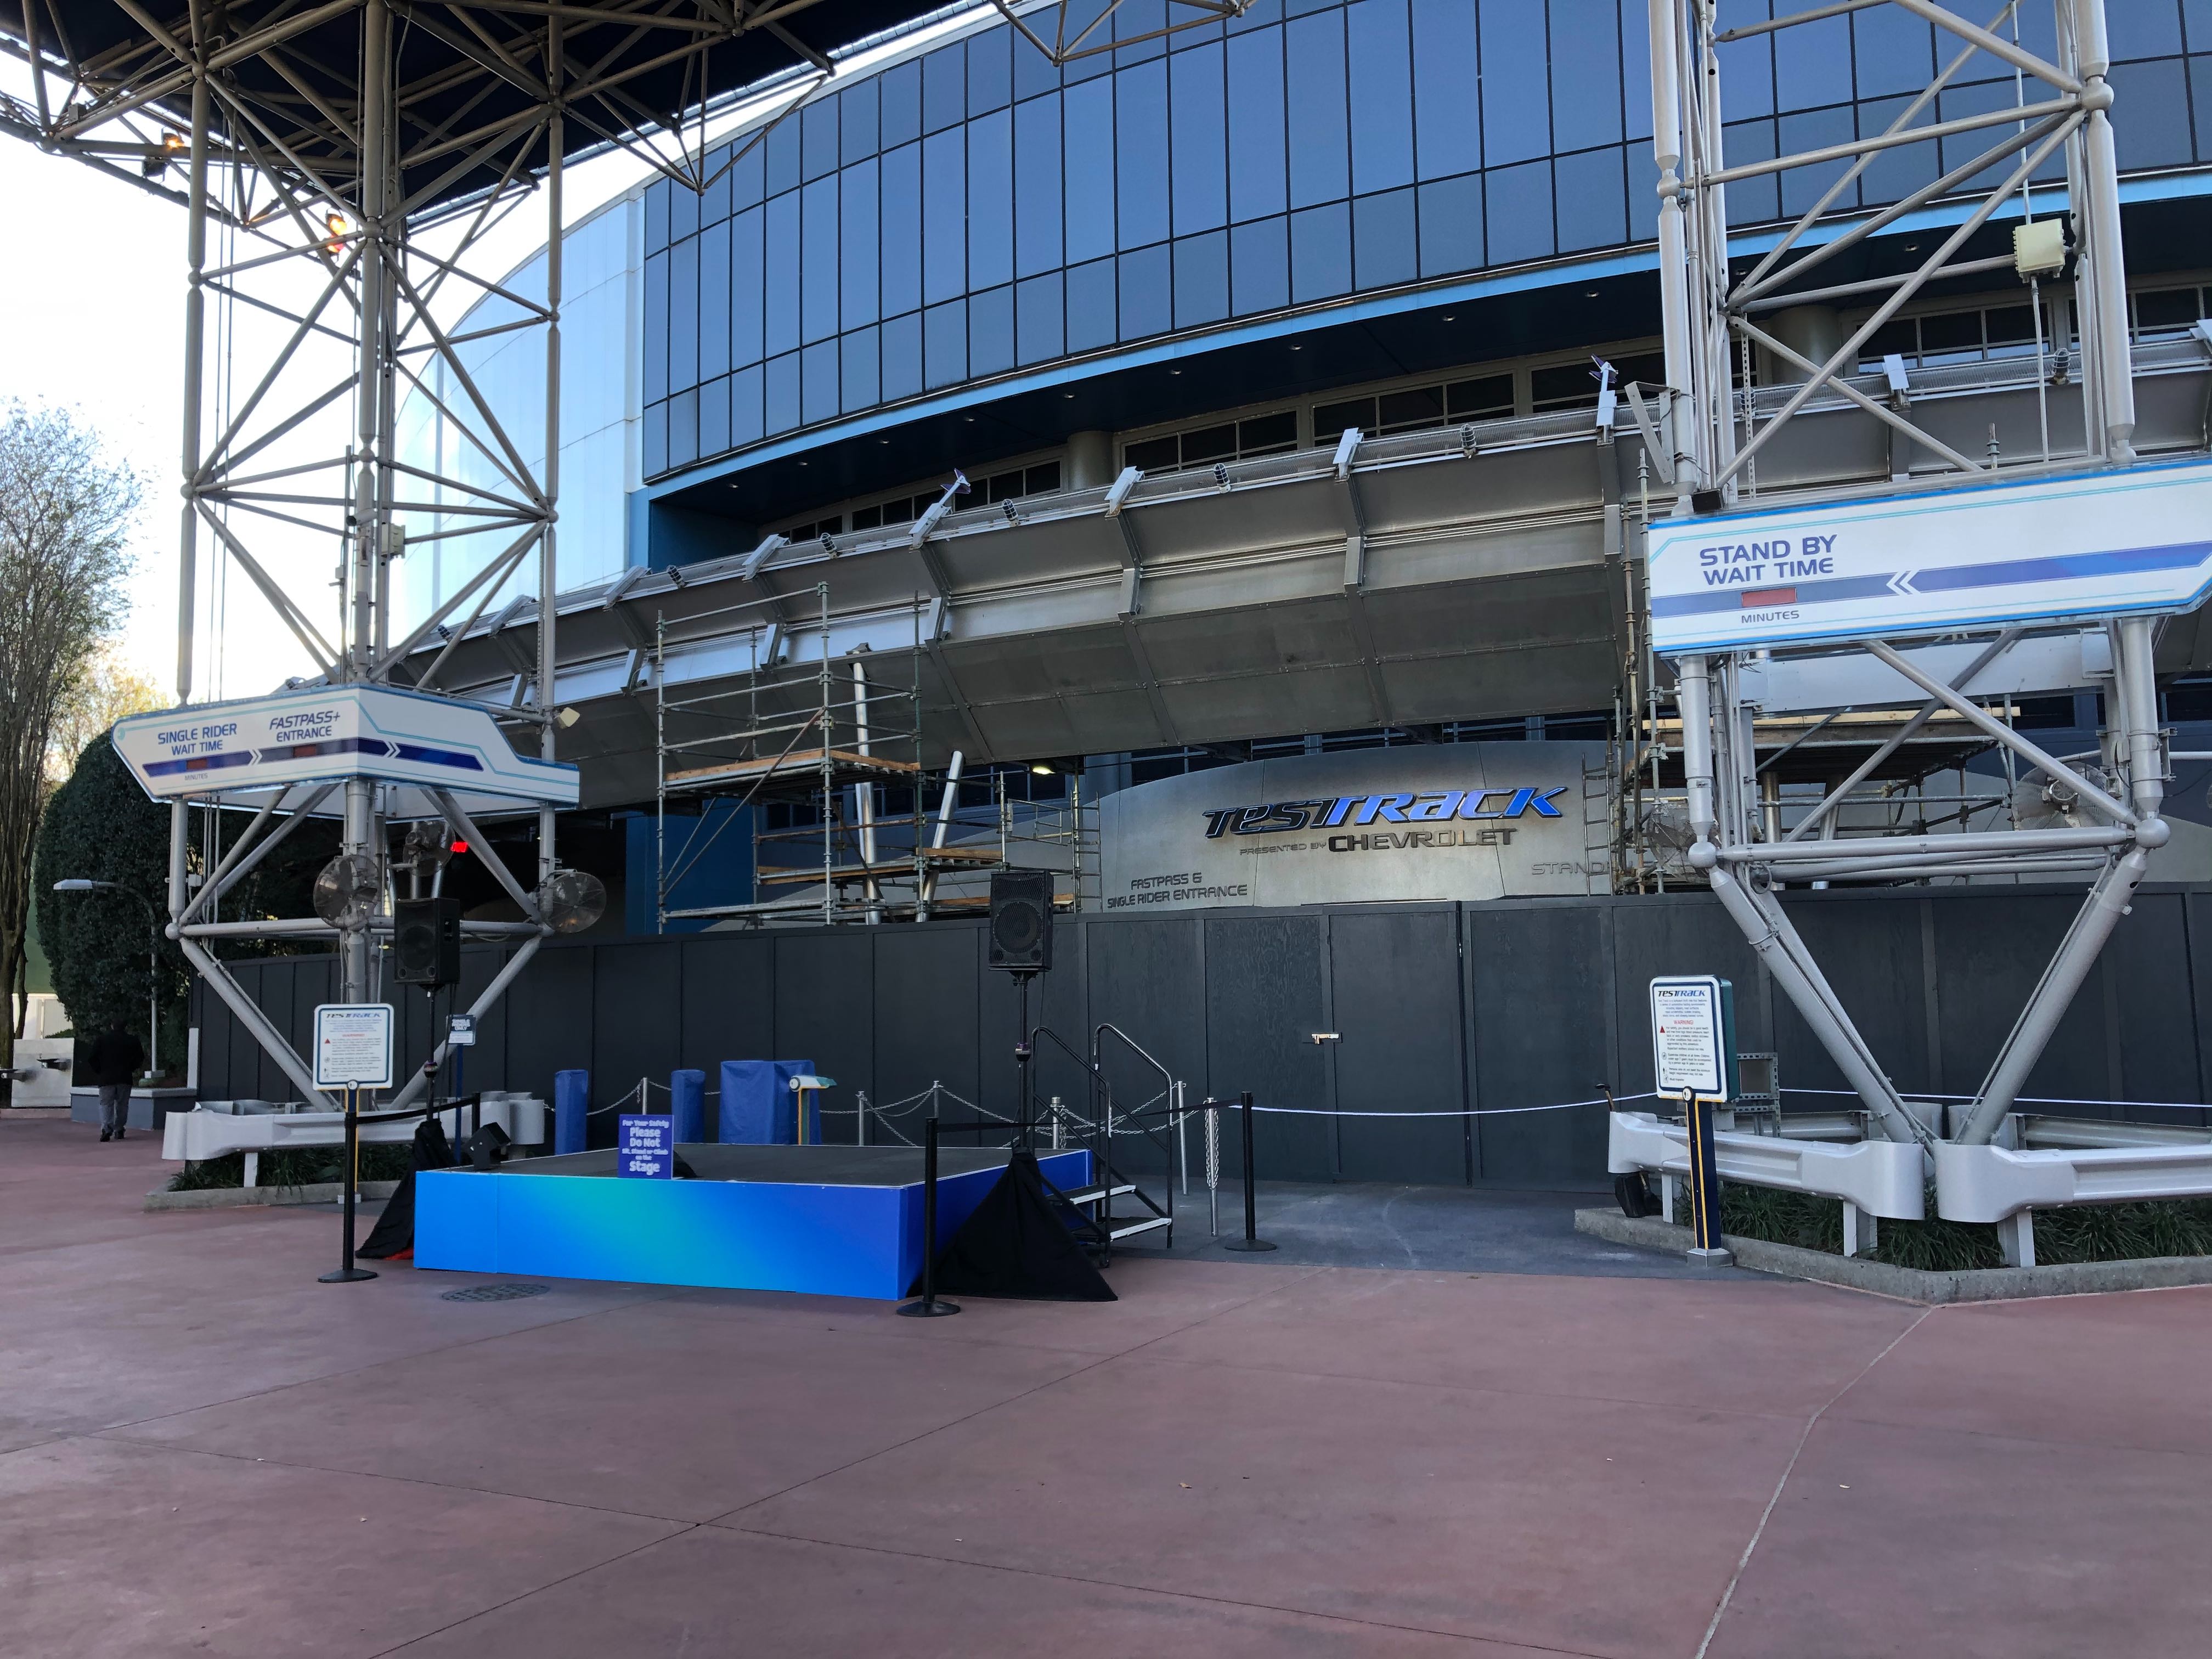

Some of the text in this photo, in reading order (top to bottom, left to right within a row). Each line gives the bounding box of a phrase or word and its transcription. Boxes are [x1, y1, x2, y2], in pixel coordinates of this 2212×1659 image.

[1700, 534, 1838, 567] STAND BY
[1703, 557, 1834, 586] WAIT TIME
[1741, 610, 1800, 624] MINUTES
[157, 723, 238, 745] SINGLE RIDER
[276, 725, 332, 742] ENTRANCE
[171, 740, 223, 755] WAIT TIME
[184, 772, 208, 781] MINUTES
[1239, 828, 1518, 856] PRESENTED BY CHEVROLET
[1131, 872, 1203, 890] FASTPASS &
[1107, 884, 1248, 909] SINGLE RIDER ENTRANCE
[630, 1127, 661, 1137] Please
[630, 1137, 661, 1147] Do Not
[629, 1160, 661, 1175] Stage
